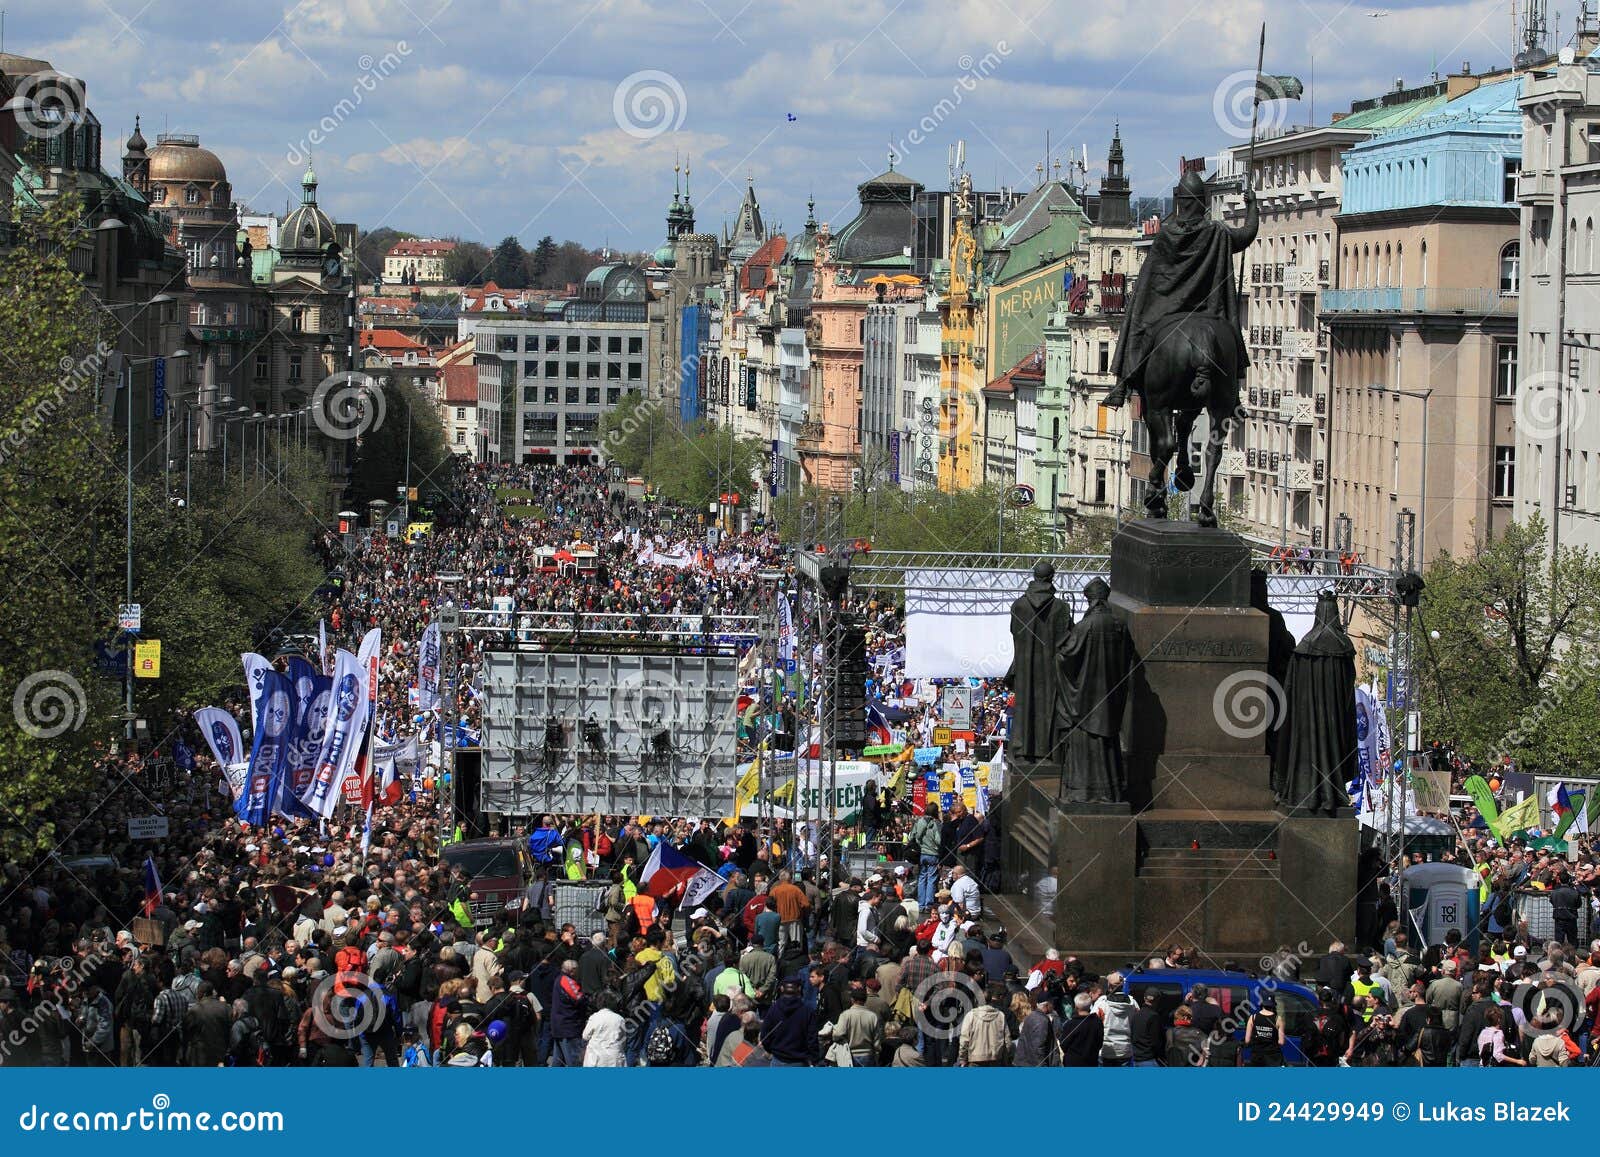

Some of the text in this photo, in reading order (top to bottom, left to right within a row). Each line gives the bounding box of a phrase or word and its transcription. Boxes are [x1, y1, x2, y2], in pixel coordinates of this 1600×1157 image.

[1001, 281, 1055, 317] MERAN
[156, 358, 164, 416] ROKOKO
[891, 433, 899, 480] CABARET
[786, 660, 794, 671] P
[345, 779, 361, 790] STOP
